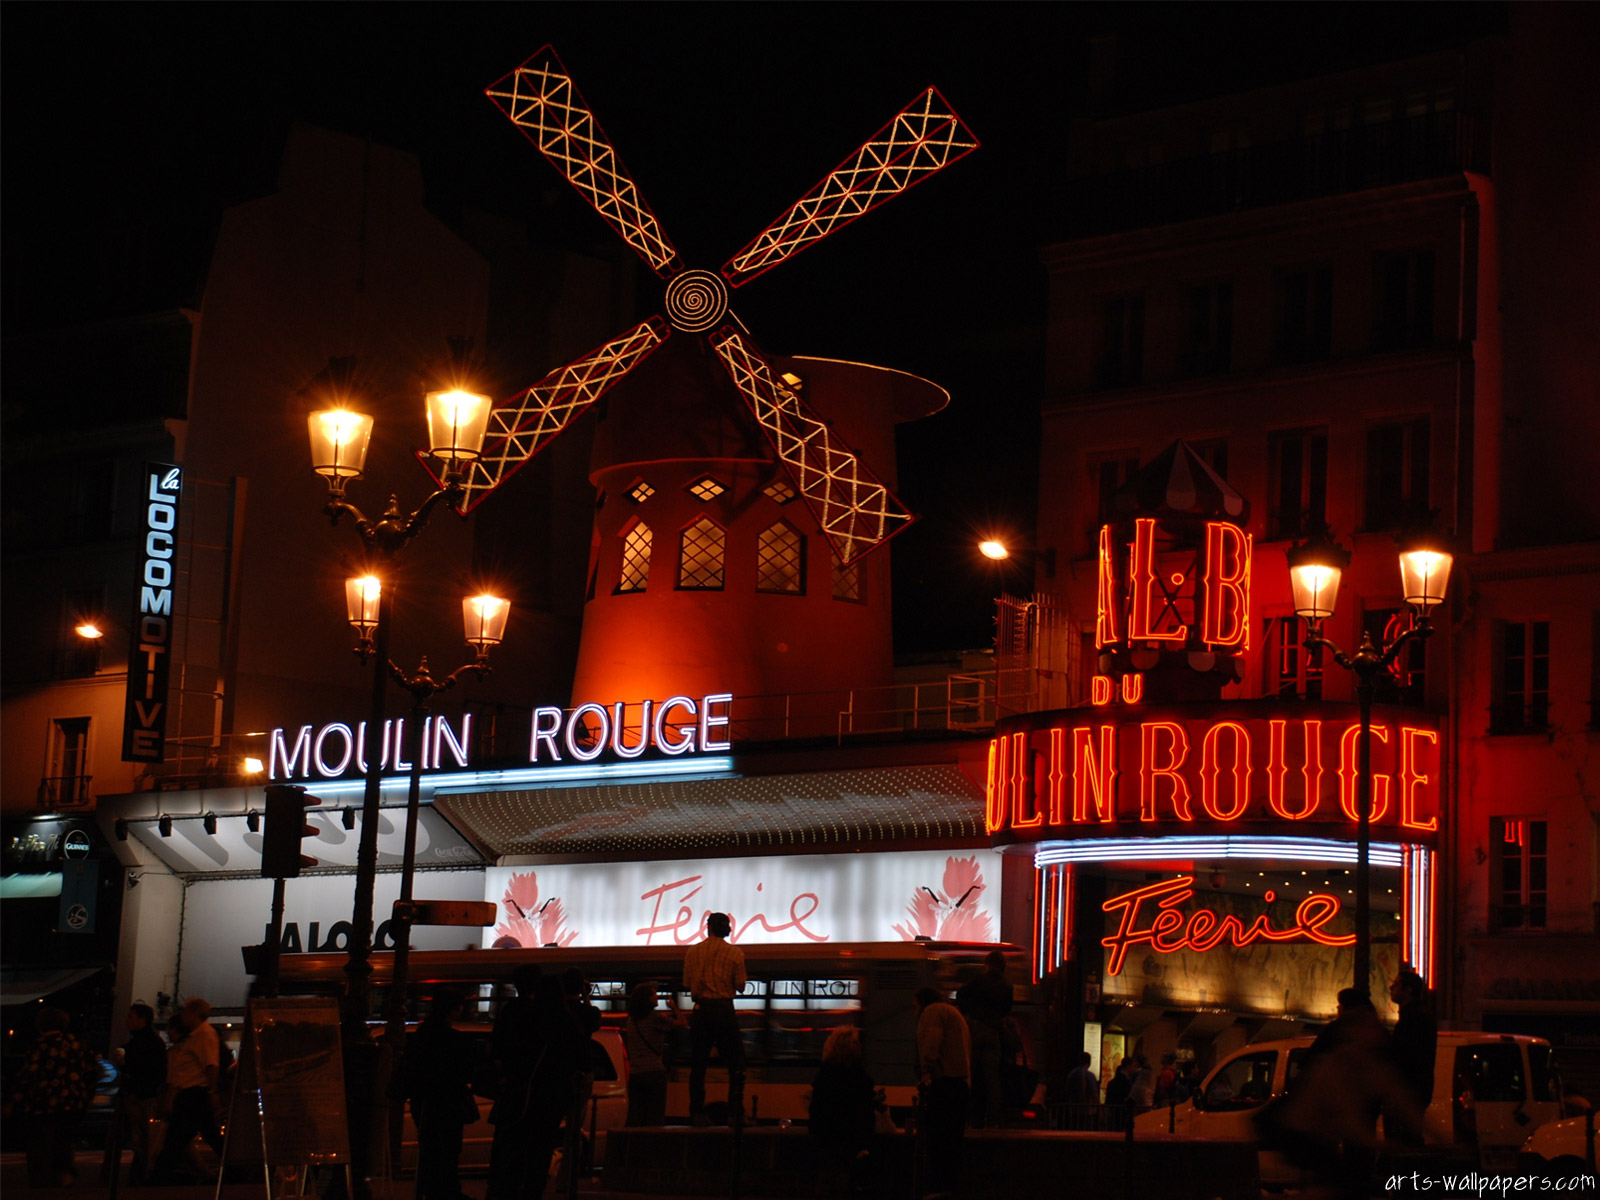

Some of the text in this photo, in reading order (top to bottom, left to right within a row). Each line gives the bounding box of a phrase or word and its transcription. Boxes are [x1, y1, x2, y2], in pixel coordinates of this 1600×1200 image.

[160, 467, 180, 490] la
[132, 474, 177, 758] LOCOMOTIVE
[1092, 674, 1142, 706] DU
[268, 693, 733, 780] MOULIN ROUGE
[986, 720, 1438, 836] ULIN ROUGE
